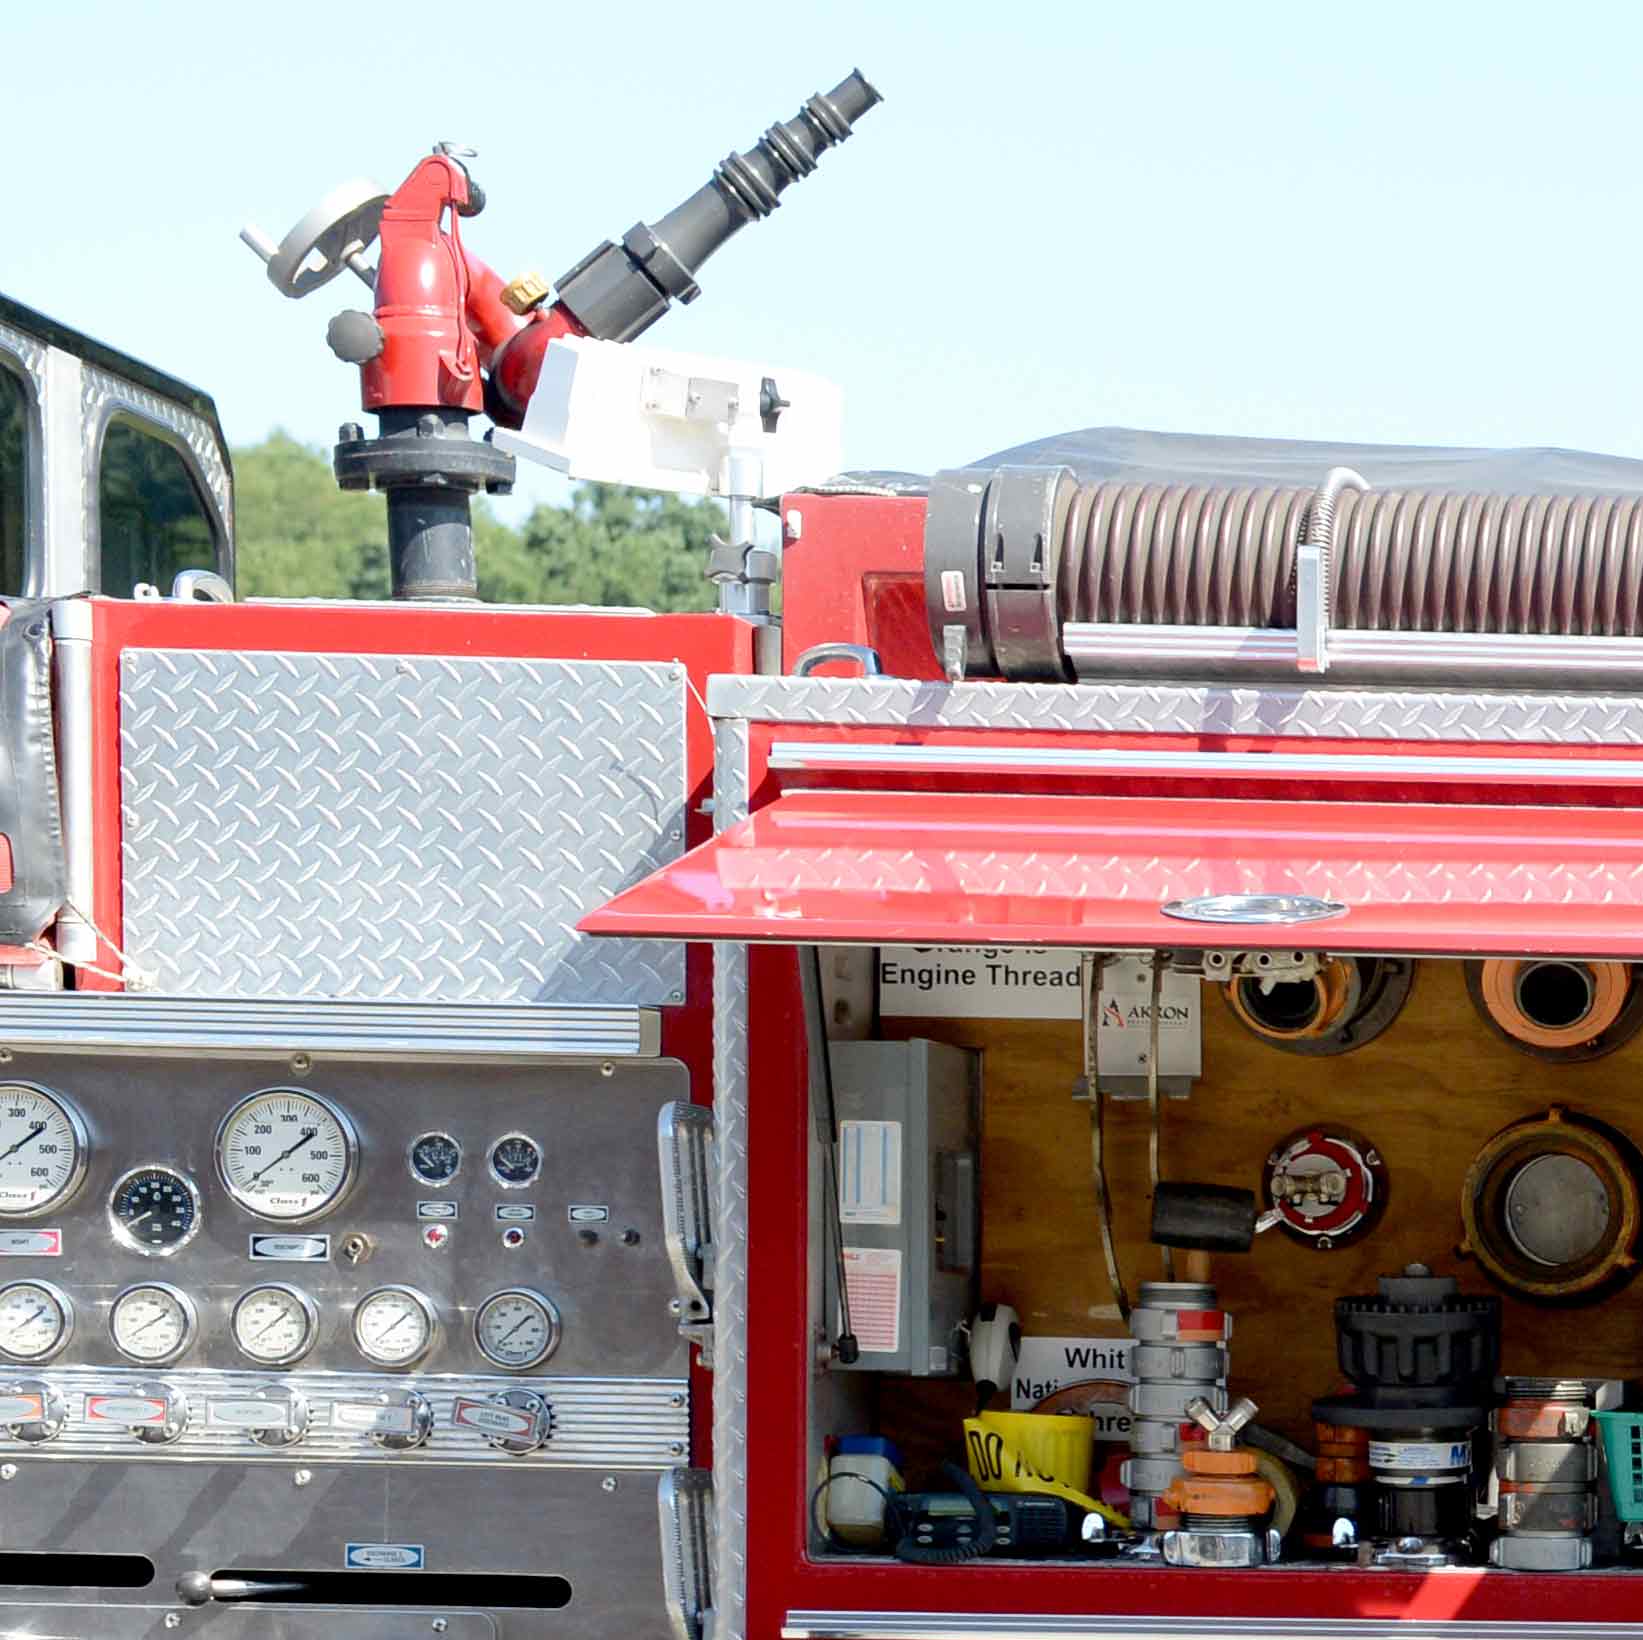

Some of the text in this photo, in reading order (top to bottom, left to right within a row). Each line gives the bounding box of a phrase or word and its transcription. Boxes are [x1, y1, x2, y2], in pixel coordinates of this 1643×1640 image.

[881, 963, 1081, 991] Engine Thread
[8, 1108, 26, 1118] 300
[29, 1120, 48, 1131] 400
[254, 1124, 272, 1135] 200
[38, 1144, 58, 1155] 500
[244, 1145, 262, 1156] 100
[310, 1150, 329, 1161] 500
[30, 1167, 49, 1178] 600
[302, 1173, 320, 1184] 600
[968, 1430, 1004, 1482] DO
